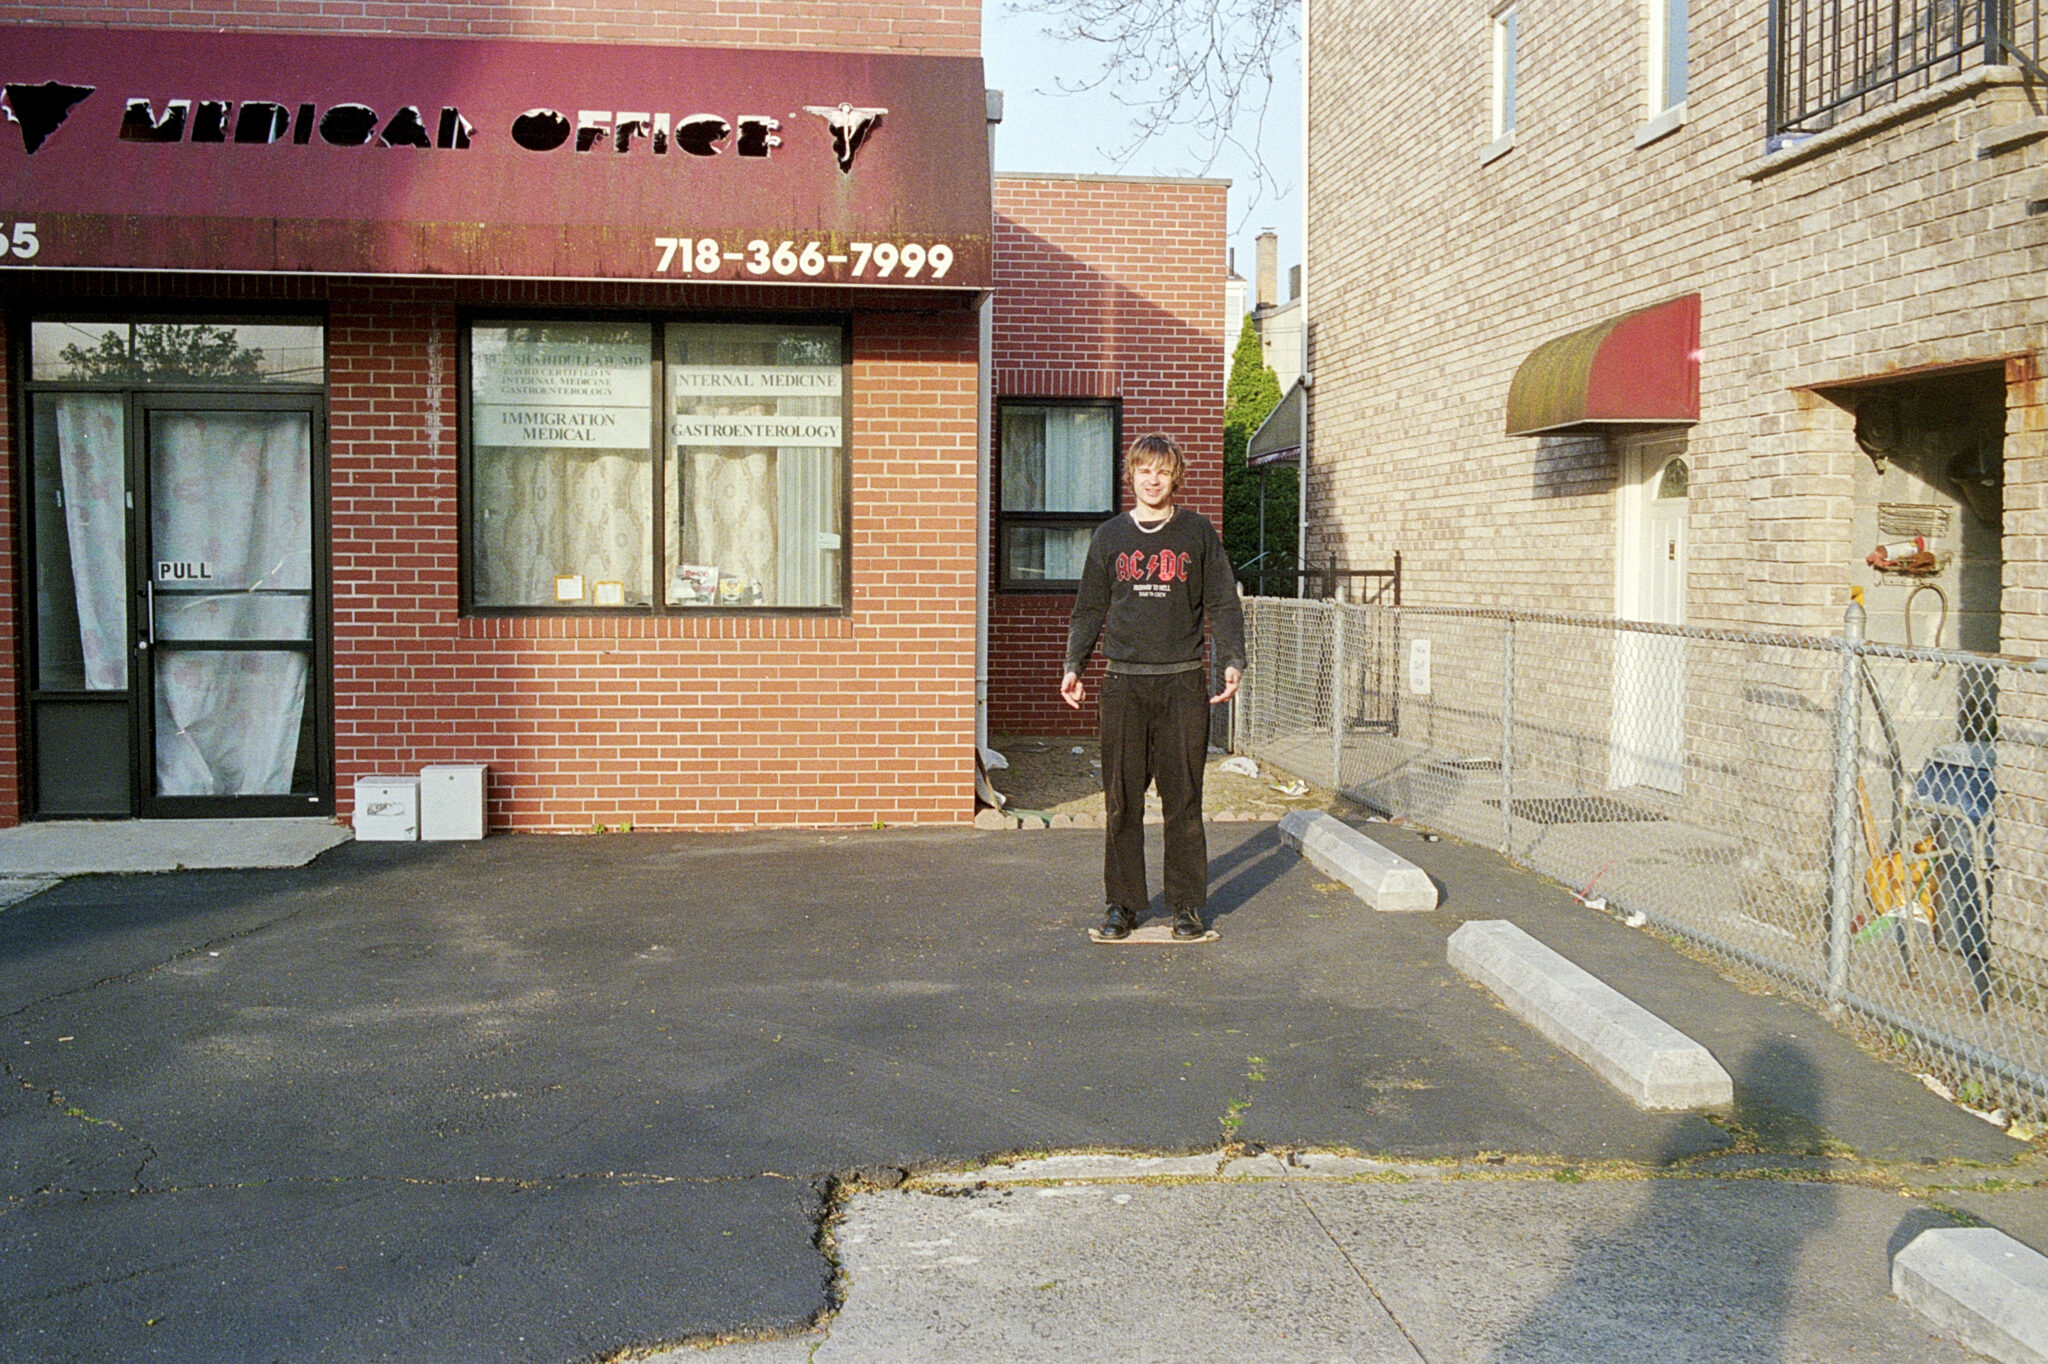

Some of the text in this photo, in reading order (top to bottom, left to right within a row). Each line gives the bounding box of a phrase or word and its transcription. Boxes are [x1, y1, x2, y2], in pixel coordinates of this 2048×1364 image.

[511, 107, 783, 158] OFFICE
[654, 236, 955, 279] 718-366-7999
[674, 373, 837, 387] INTERNAL MEDICINE
[502, 411, 616, 426] IMMIGRATION
[522, 428, 596, 442] MEDICAL
[671, 425, 839, 438] GASTROENTEROLOGY
[160, 562, 212, 579] PULL
